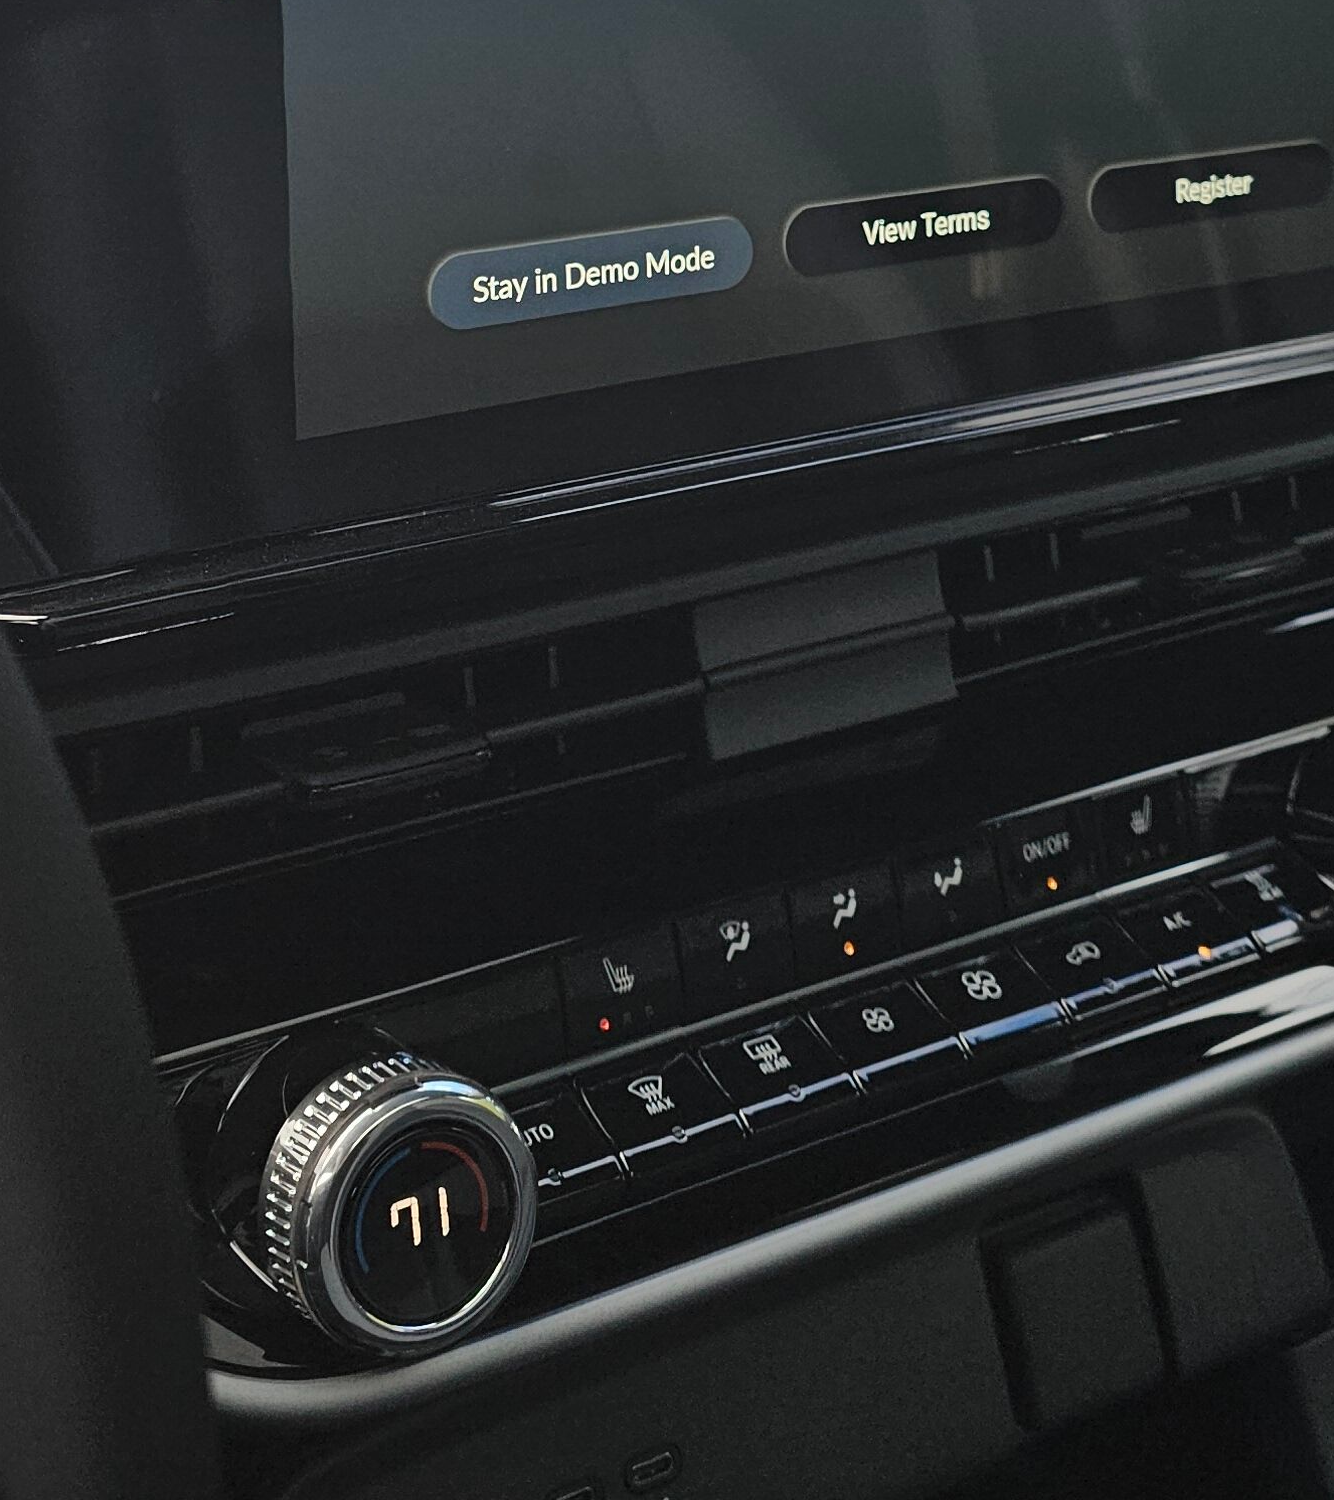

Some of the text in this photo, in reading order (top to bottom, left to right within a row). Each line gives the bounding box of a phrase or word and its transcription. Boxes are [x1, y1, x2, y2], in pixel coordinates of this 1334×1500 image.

[1175, 173, 1254, 205] Register
[861, 209, 991, 246] View Terms
[473, 244, 715, 303] Stay in Demo Mode
[645, 1095, 675, 1116] MAX
[389, 1186, 450, 1247] 71
